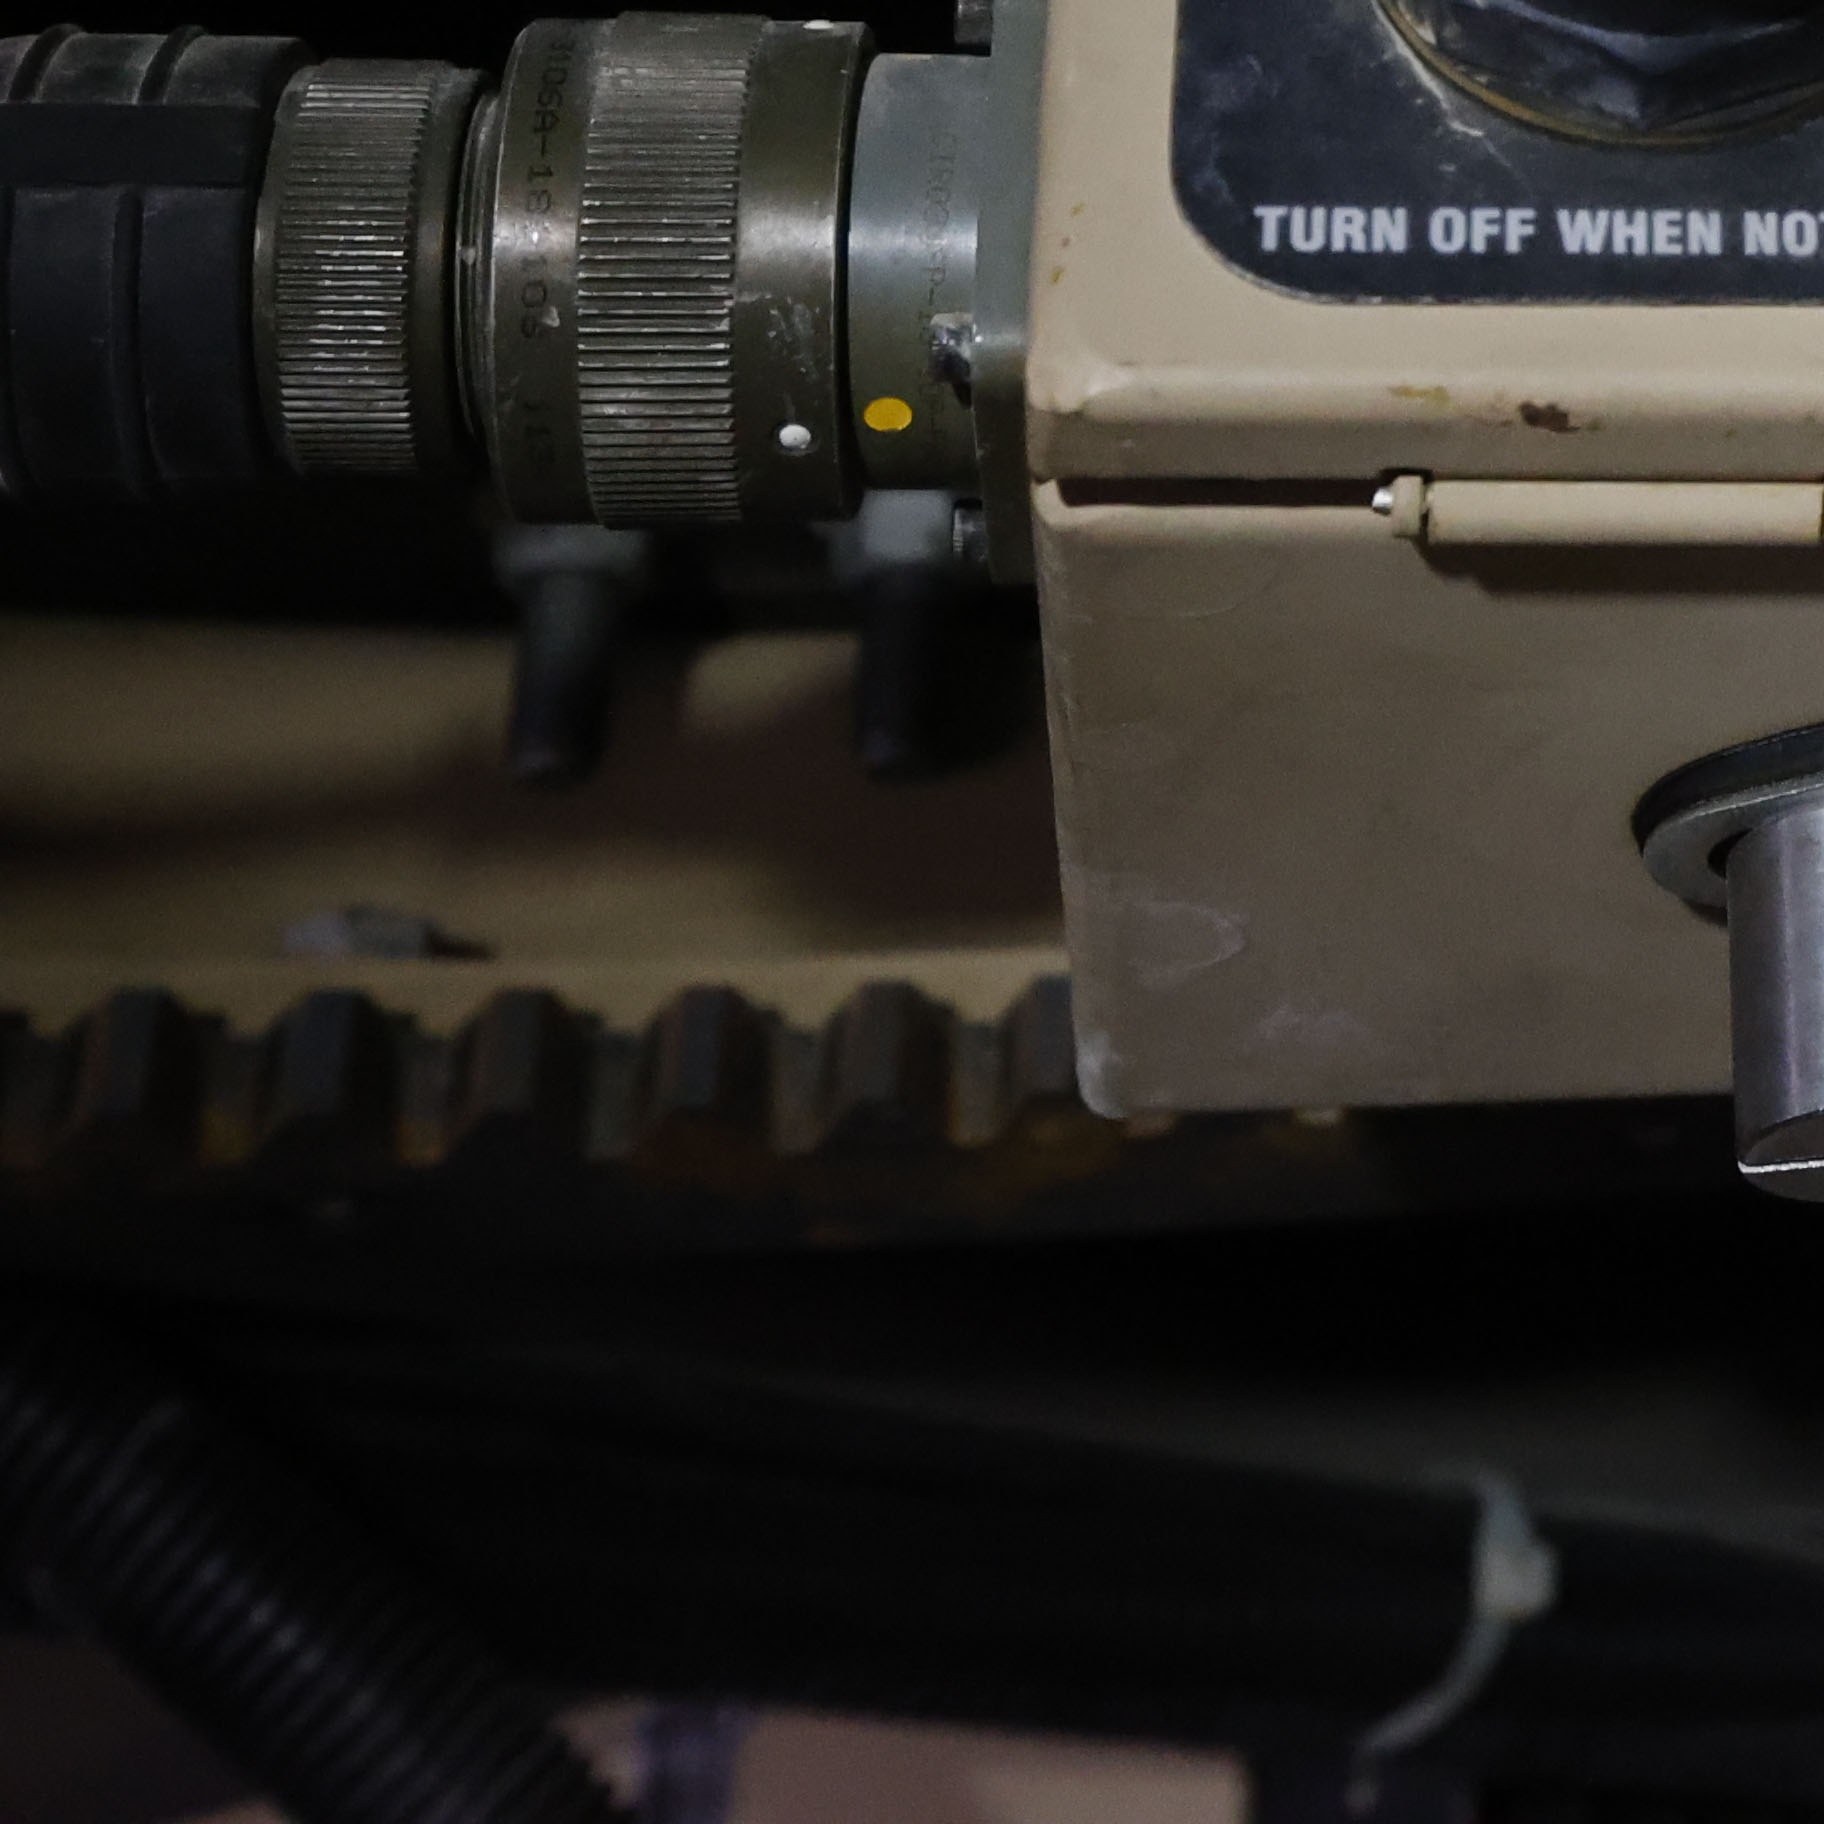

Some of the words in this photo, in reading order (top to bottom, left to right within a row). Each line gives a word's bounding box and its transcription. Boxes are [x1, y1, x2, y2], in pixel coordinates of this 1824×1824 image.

[1253, 204, 1407, 255] TURN
[1428, 207, 1537, 255] OFF
[1556, 209, 1721, 256] WHEN
